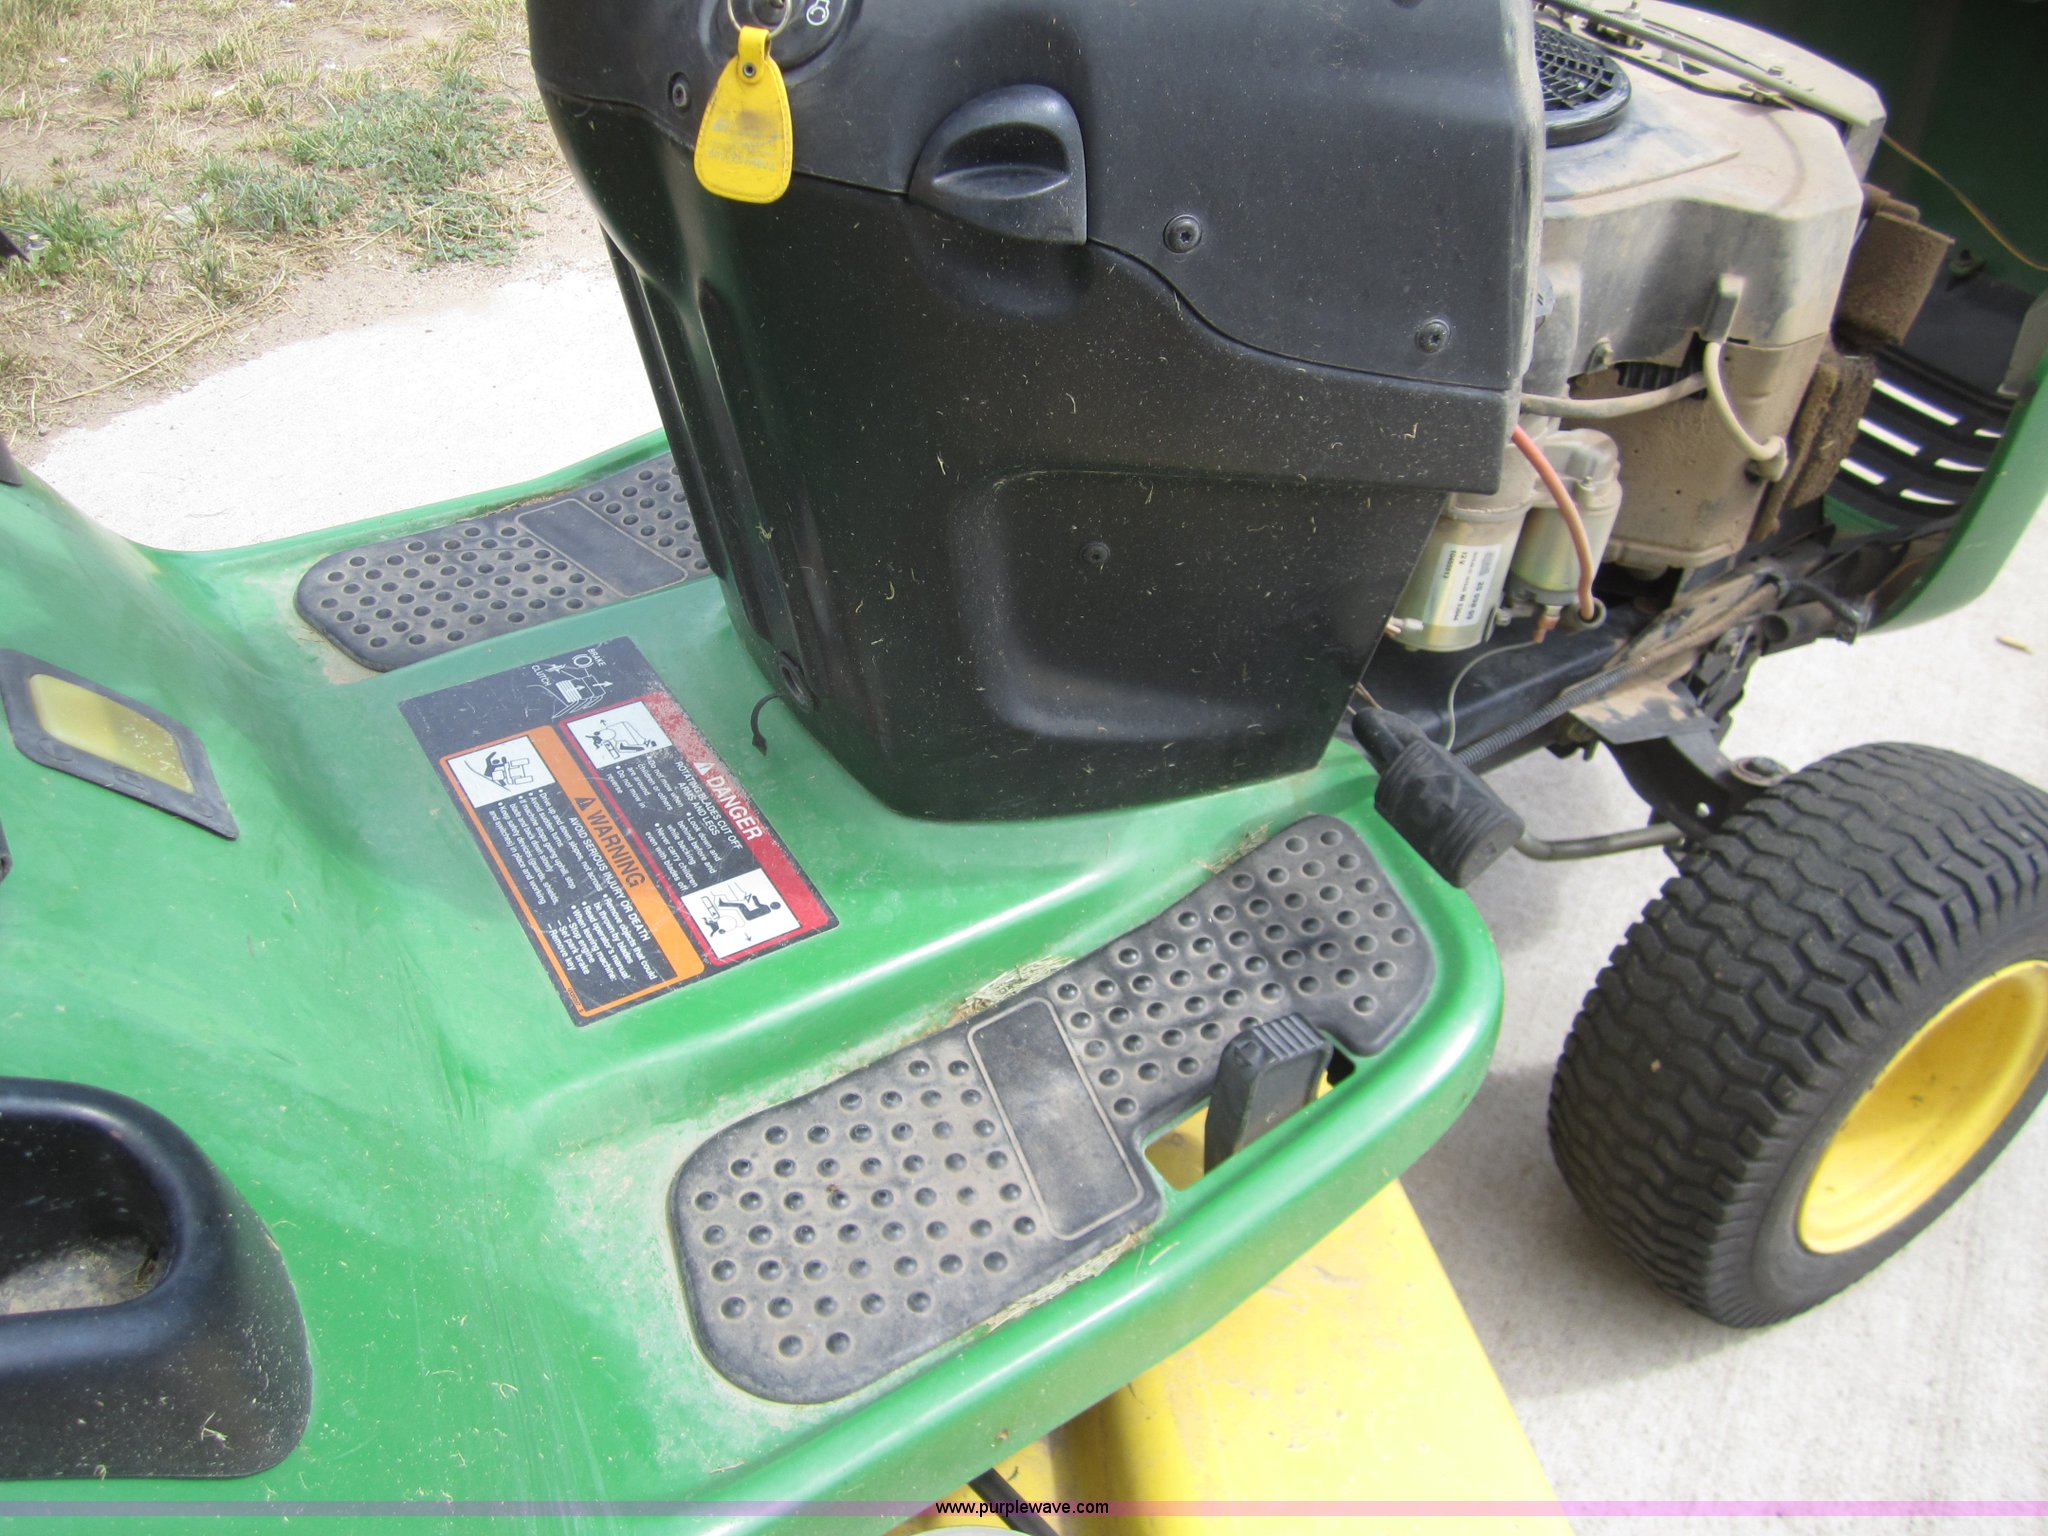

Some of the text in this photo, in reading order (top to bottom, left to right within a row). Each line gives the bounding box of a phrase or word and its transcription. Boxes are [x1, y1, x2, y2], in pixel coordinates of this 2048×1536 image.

[530, 663, 552, 686] CLUTCH
[587, 647, 607, 667] BRAKE
[538, 792, 553, 806] Drive
[605, 773, 623, 794] reverse
[615, 769, 627, 778] Do
[621, 778, 633, 788] not
[628, 787, 641, 802] mow
[626, 766, 651, 796] are around
[636, 762, 657, 785] children
[656, 791, 674, 810] others
[647, 759, 684, 808] Do not mow when
[488, 809, 500, 821] and
[529, 796, 565, 847] Avoid sudden turns
[545, 806, 556, 815] up
[551, 813, 564, 825] and
[674, 760, 743, 850] ROTATING BLADES CUT OFF
[677, 781, 720, 835] ARMS AND LEGS
[704, 774, 764, 840] DANGER
[496, 805, 512, 821] Keep
[504, 819, 522, 837] safety
[515, 835, 534, 858] devices
[508, 802, 555, 873] blade and back down slowly
[509, 845, 518, 853] in
[521, 803, 540, 826] machine
[533, 826, 549, 842] stops
[542, 841, 559, 859] going
[562, 875, 577, 890] stop
[558, 824, 573, 841] down
[584, 809, 647, 888] WARNING
[665, 823, 698, 865] while backing
[676, 820, 717, 873] behind before and
[686, 816, 722, 861] Look down and
[510, 851, 527, 869] place
[521, 867, 534, 880] and
[580, 860, 591, 871] not
[644, 831, 688, 891] even with blades off
[655, 827, 700, 887] Never carry children
[526, 879, 548, 905] working
[567, 816, 650, 941] AVOID SERIOUS INJURY OR DEATH
[586, 871, 603, 891] across
[570, 908, 619, 981] When leaving machine:
[575, 938, 596, 964] engine
[581, 905, 598, 922] Read
[610, 953, 630, 979] manual
[592, 901, 635, 964] be thrown by blades
[602, 897, 657, 980] Remove objects that could
[562, 937, 580, 955] park
[573, 953, 592, 975] brake
[562, 957, 578, 972] key
